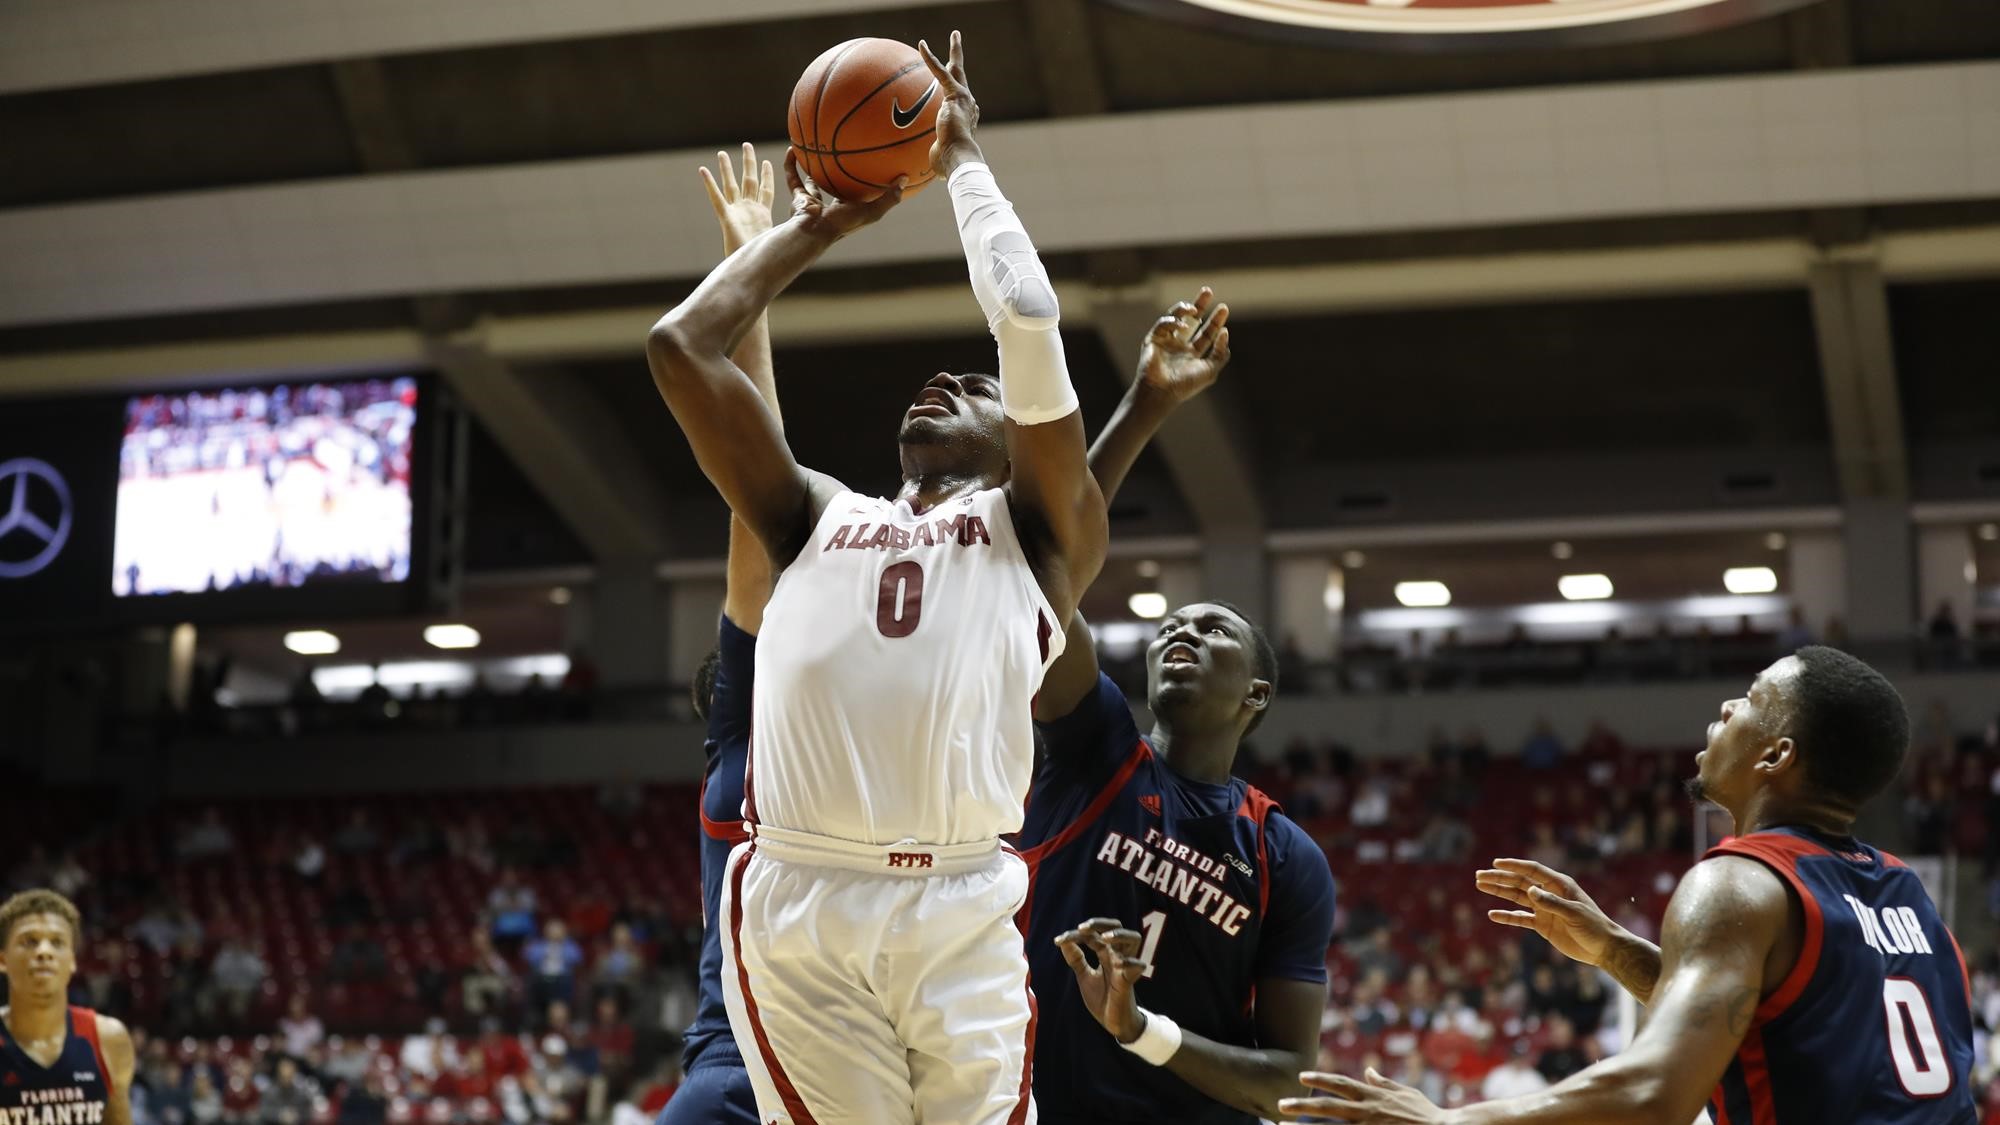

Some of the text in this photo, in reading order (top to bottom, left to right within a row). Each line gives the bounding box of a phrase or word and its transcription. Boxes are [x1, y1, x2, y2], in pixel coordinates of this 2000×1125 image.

[824, 514, 991, 552] ALABAMA
[877, 561, 923, 637] 0
[887, 852, 933, 868] RTR
[1097, 832, 1251, 936] ATLANTIC
[1138, 910, 1167, 979] 1
[1882, 976, 1953, 1099] 0
[0, 1101, 105, 1125] ATLANTIC
[20, 1087, 84, 1105] FLORIDA
